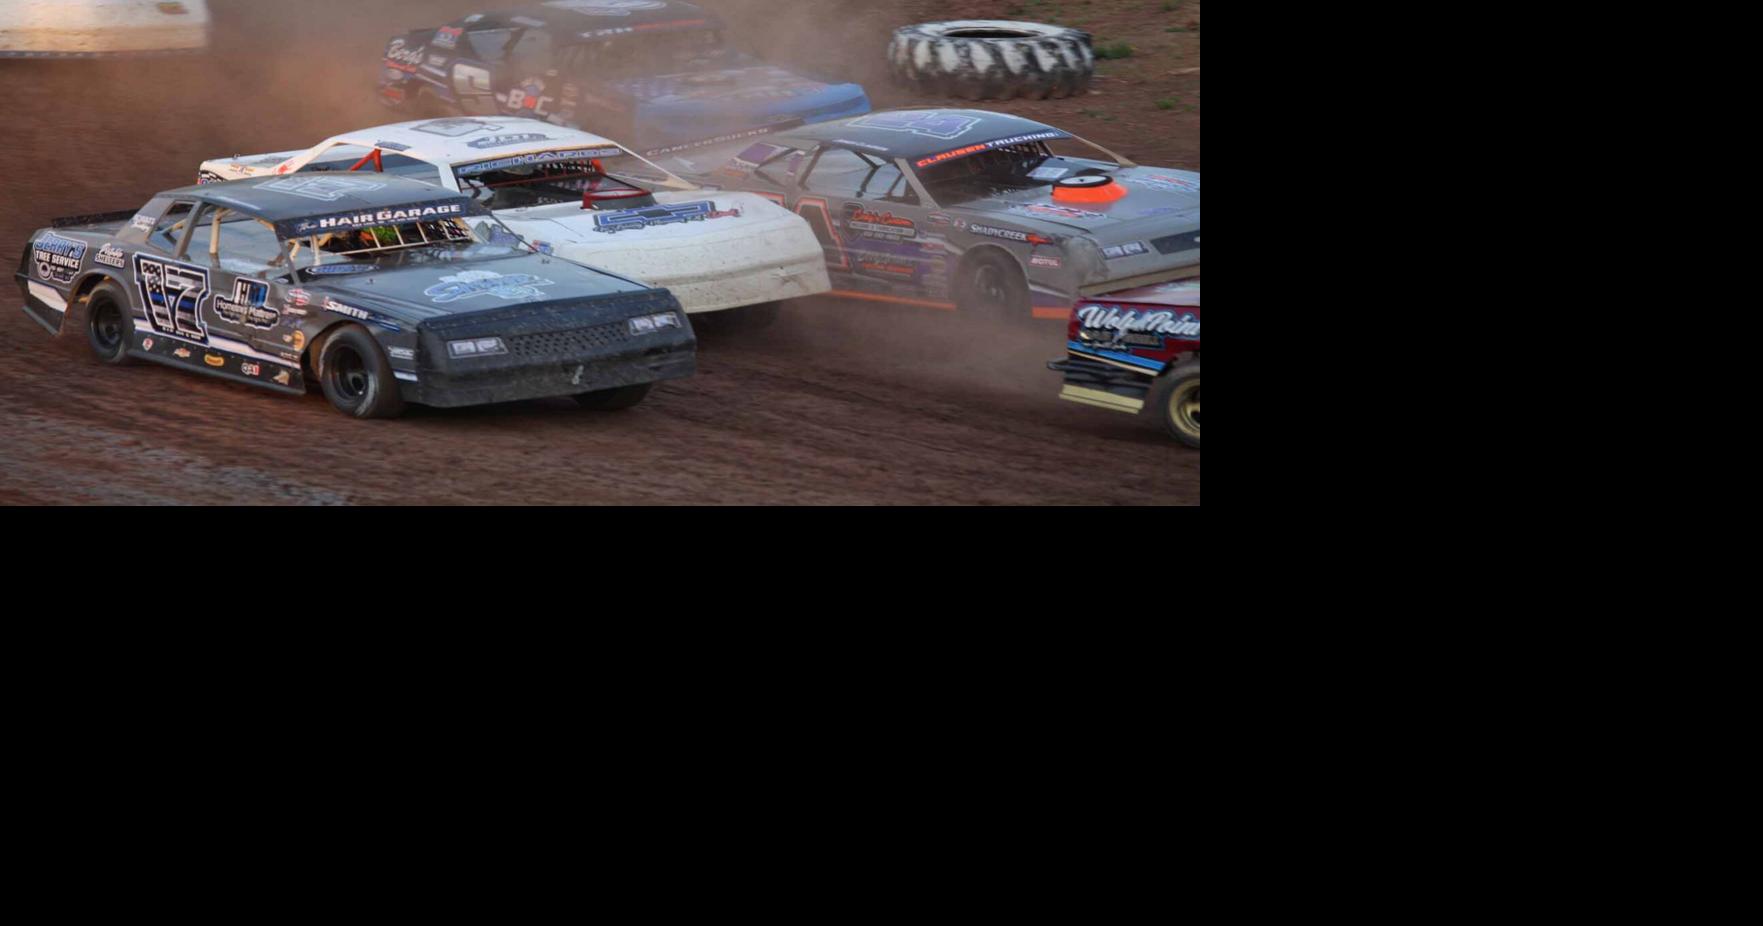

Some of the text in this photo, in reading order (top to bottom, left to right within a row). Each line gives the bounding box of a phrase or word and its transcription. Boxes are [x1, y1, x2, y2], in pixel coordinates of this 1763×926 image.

[916, 131, 1056, 168] CLAUSEN TRUCKING
[319, 212, 373, 228] HAIR
[376, 204, 462, 222] GARAGE
[35, 234, 85, 260] JERRY'S
[35, 250, 80, 269] TREE SERVICE
[136, 256, 208, 342] 17
[326, 300, 369, 321] SMITH
